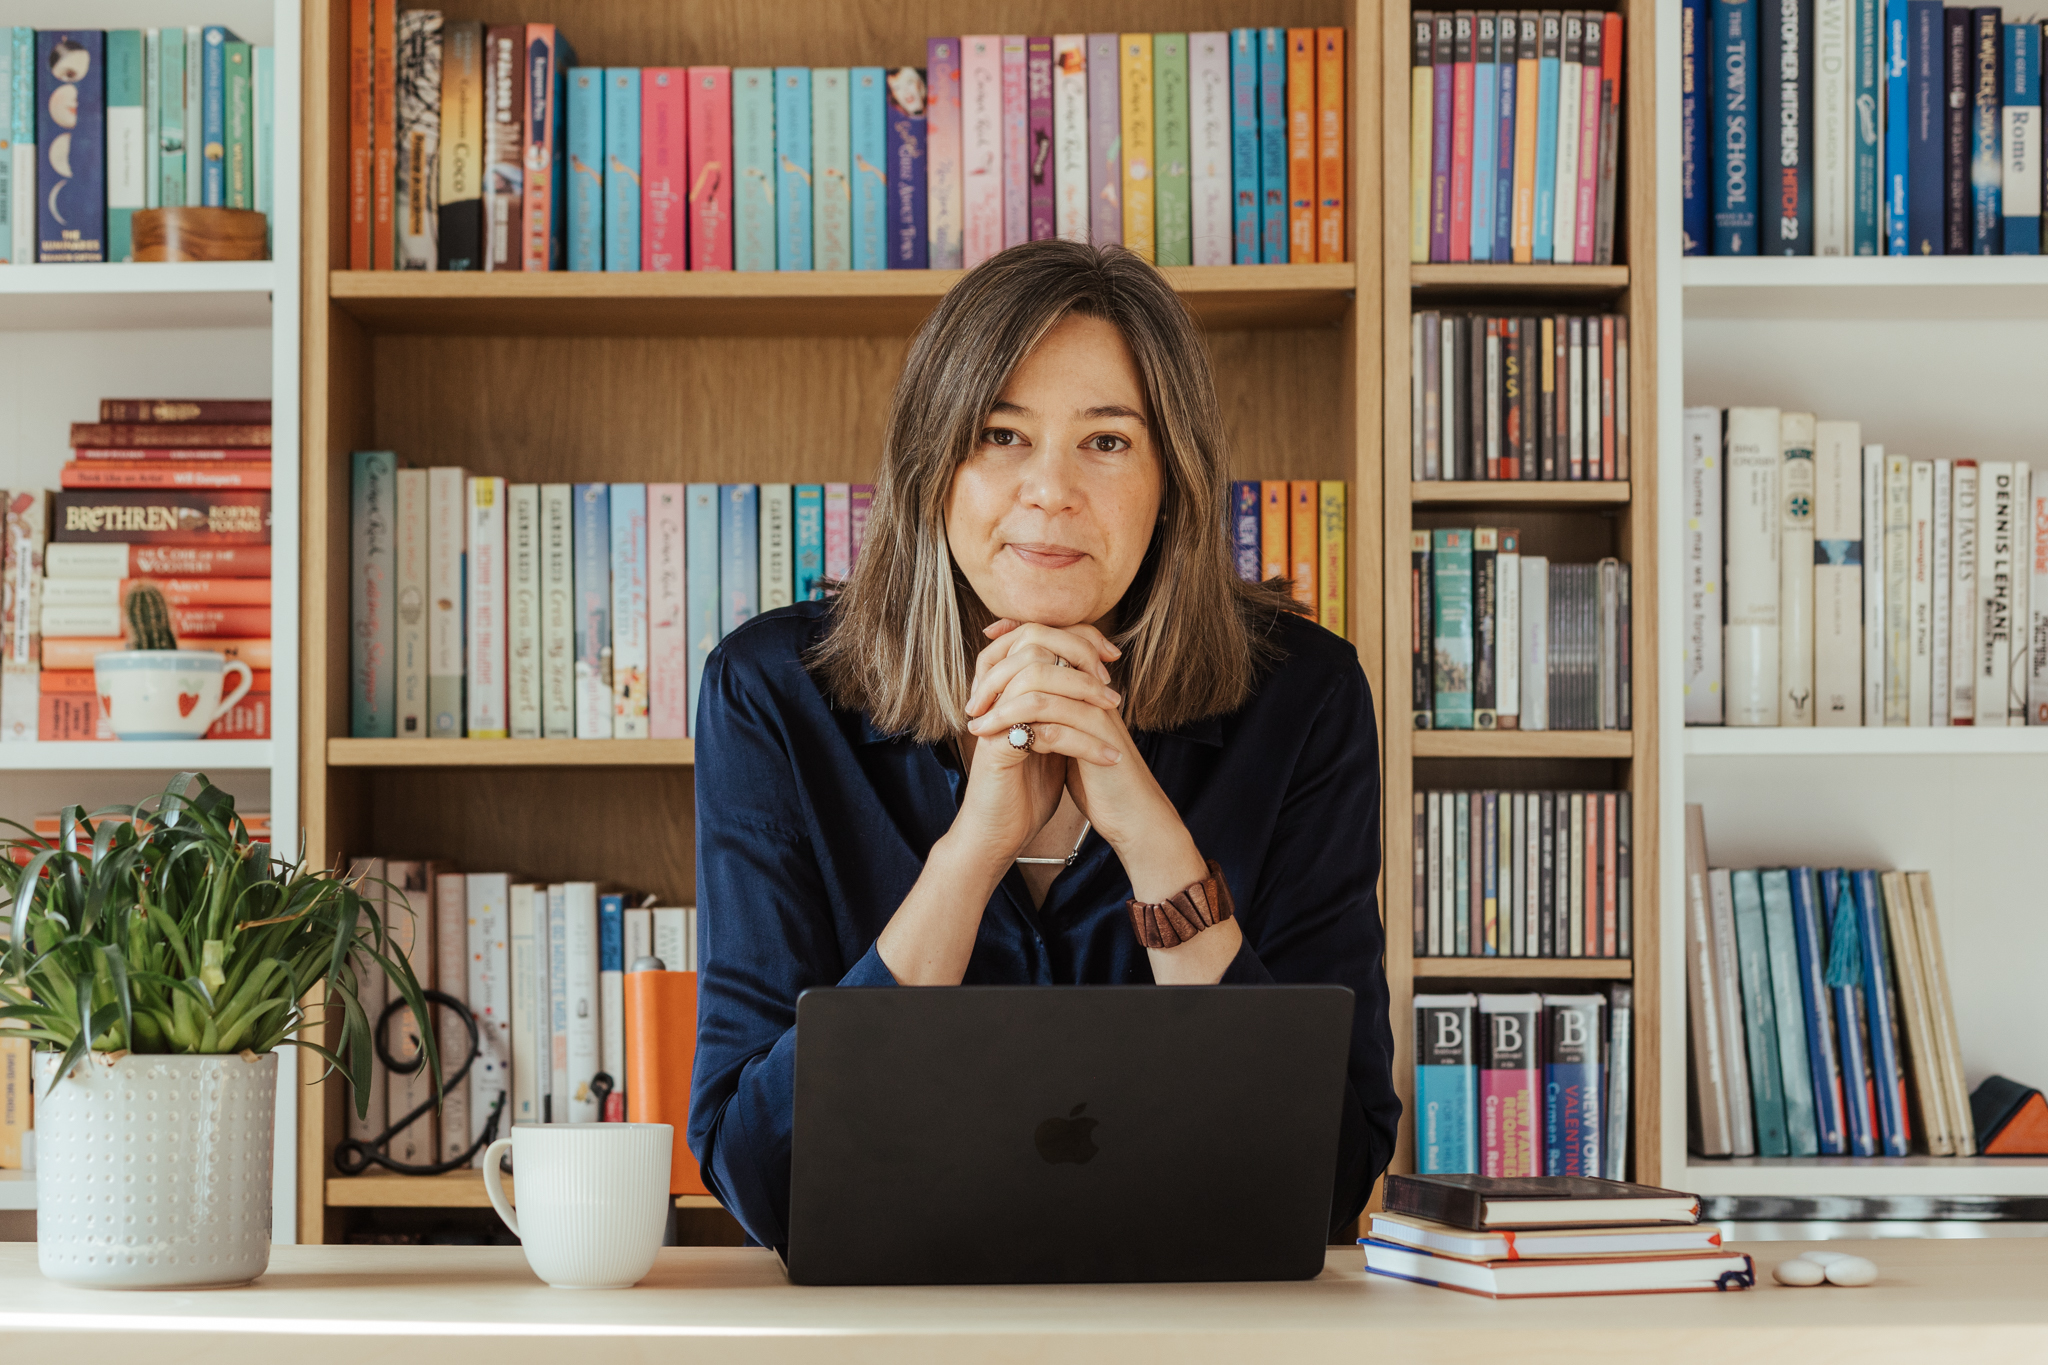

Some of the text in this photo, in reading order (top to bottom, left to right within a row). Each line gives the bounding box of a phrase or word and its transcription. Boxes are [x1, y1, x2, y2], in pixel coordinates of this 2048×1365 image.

[1822, 6, 1842, 75] WILD
[1726, 10, 1746, 209] THE TOWN SCHOOL
[1781, 82, 1798, 166] HITCHENS
[452, 142, 471, 192] Coco
[2012, 112, 2029, 172] Rome
[1694, 469, 1705, 516] homes
[66, 506, 178, 532] BRETHREN
[1956, 478, 1975, 582] P.D. JAMES
[1690, 531, 1702, 560] may
[1994, 475, 2010, 643] DENNIS LEHANE
[1693, 592, 1705, 608] be
[1694, 567, 1702, 585] we
[1434, 1012, 1462, 1048] B
[1496, 1016, 1522, 1052] B
[1560, 1010, 1588, 1046] B
[1486, 1095, 1499, 1147] Carmen
[1547, 1082, 1560, 1144] Carmen
[1583, 1086, 1598, 1128] NEW
[1428, 1102, 1439, 1170] Carmen Reid
[1517, 1090, 1530, 1178] NEW FAMIL
